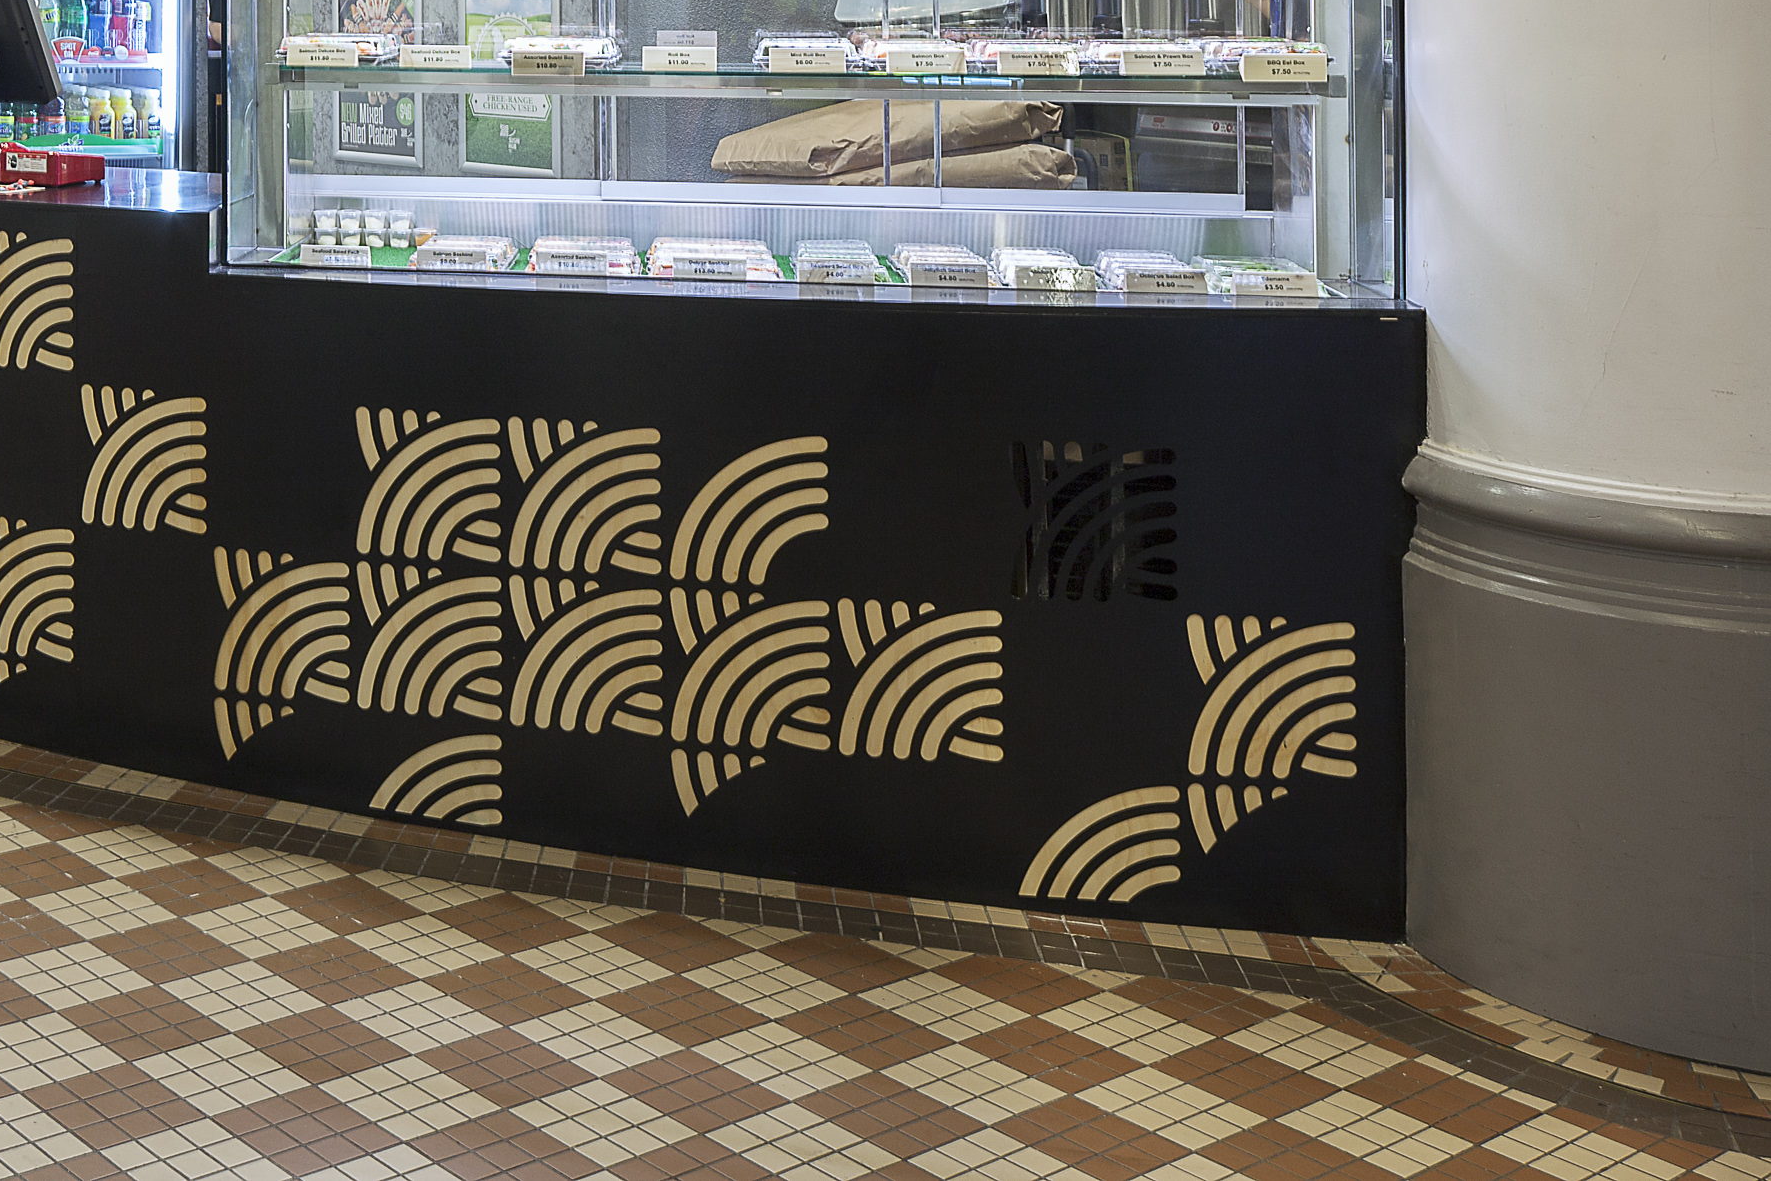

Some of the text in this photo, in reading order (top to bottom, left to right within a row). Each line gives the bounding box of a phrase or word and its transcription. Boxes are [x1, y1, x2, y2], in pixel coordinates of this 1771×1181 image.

[60, 42, 77, 52] SPOT
[63, 50, 74, 59] ON
[1027, 60, 1046, 68] $7.50
[1272, 68, 1291, 76] $7.50
[486, 94, 534, 105] FREE-RANGE
[482, 101, 538, 113] CHICKEN USED
[341, 102, 384, 125] NEW Mixed
[341, 122, 366, 144] Grilled
[368, 124, 398, 147] Platter
[1264, 283, 1284, 291] $3.50
